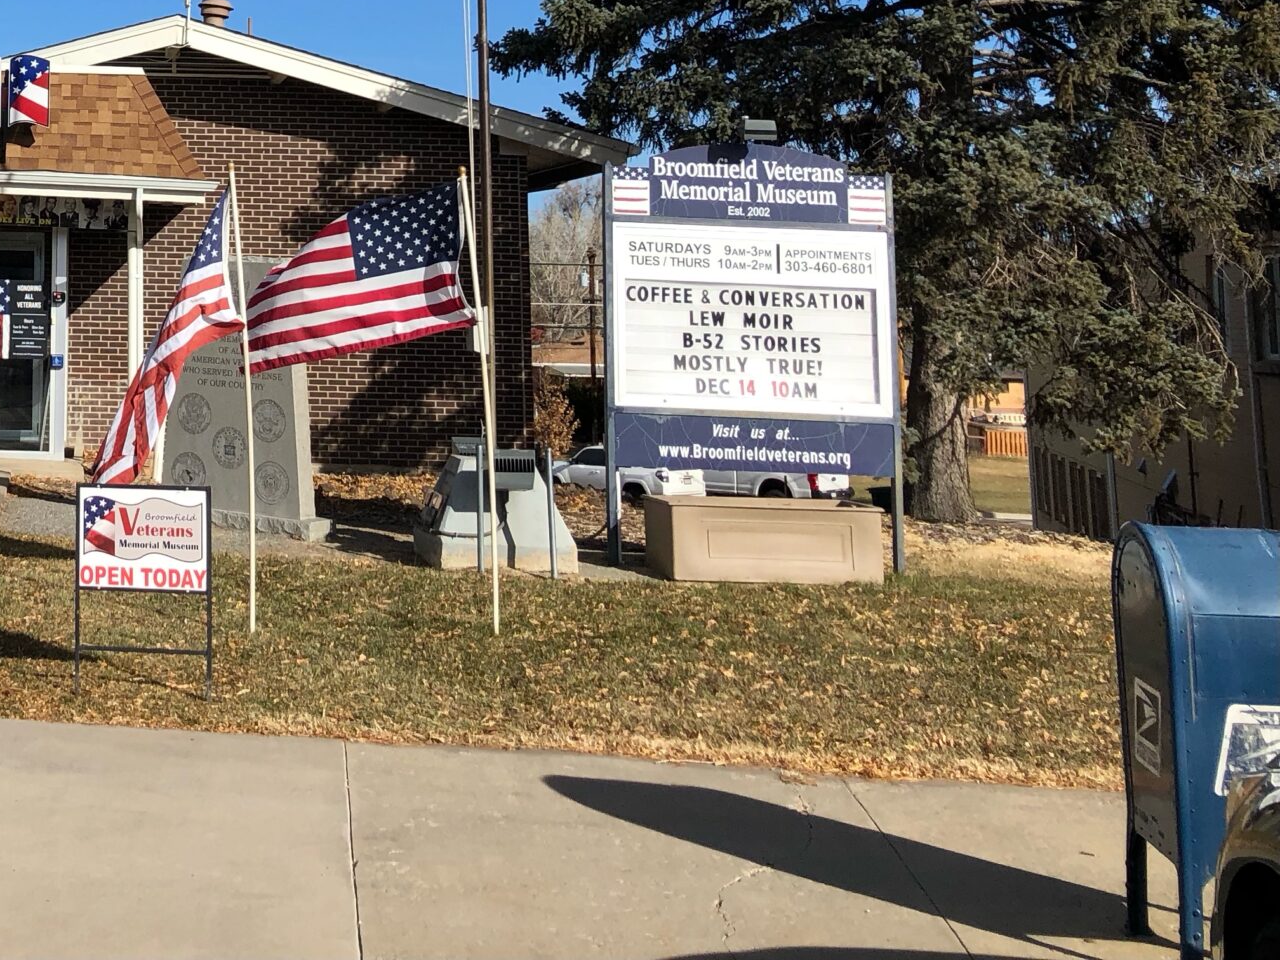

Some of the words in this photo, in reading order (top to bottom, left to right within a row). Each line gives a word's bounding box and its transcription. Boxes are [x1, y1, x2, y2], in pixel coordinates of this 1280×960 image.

[653, 155, 758, 180] Broomfield
[763, 160, 844, 183] Veterans
[660, 179, 751, 202] Memorial
[756, 184, 838, 206] Museum
[727, 206, 745, 217] Est.
[747, 206, 771, 218] 2002
[16, 217, 35, 225] LIVE
[628, 241, 712, 256] SATURDAYS
[724, 245, 772, 258] 9AM-3PM
[785, 249, 872, 261] APPOINTMENTS
[630, 255, 660, 267] TUES
[671, 256, 710, 269] THURS
[718, 258, 773, 272] 10AM-2PM
[785, 261, 873, 275] 303-460-6801
[16, 301, 42, 309] VETERANS
[626, 286, 693, 305] COFFEE
[701, 290, 711, 304] &
[719, 289, 866, 311] CONVERSATION
[689, 310, 725, 328] LEW
[743, 313, 794, 330] MOIR
[218, 346, 229, 354] OF
[683, 333, 724, 350] B-52
[741, 334, 821, 353] STORIES
[191, 355, 231, 366] AMERICAN
[673, 355, 748, 373] MOSTLY
[766, 357, 823, 376] TRUE!
[182, 366, 200, 374] WHO
[202, 367, 233, 378] SERVED
[197, 378, 209, 386] OF
[209, 379, 227, 388] OUR
[228, 381, 264, 391] COUTRY
[695, 378, 730, 395] DEC
[739, 379, 756, 396] 14
[712, 423, 740, 438] Visit
[750, 428, 765, 440] us
[658, 444, 851, 469] www.Broomfieldveterans.org
[119, 507, 193, 538] Veterans
[145, 512, 197, 523] Broomfield
[119, 539, 160, 550] Memorial
[162, 540, 199, 551] Museum
[80, 565, 134, 586] OPEN
[140, 567, 207, 589] TODAY
